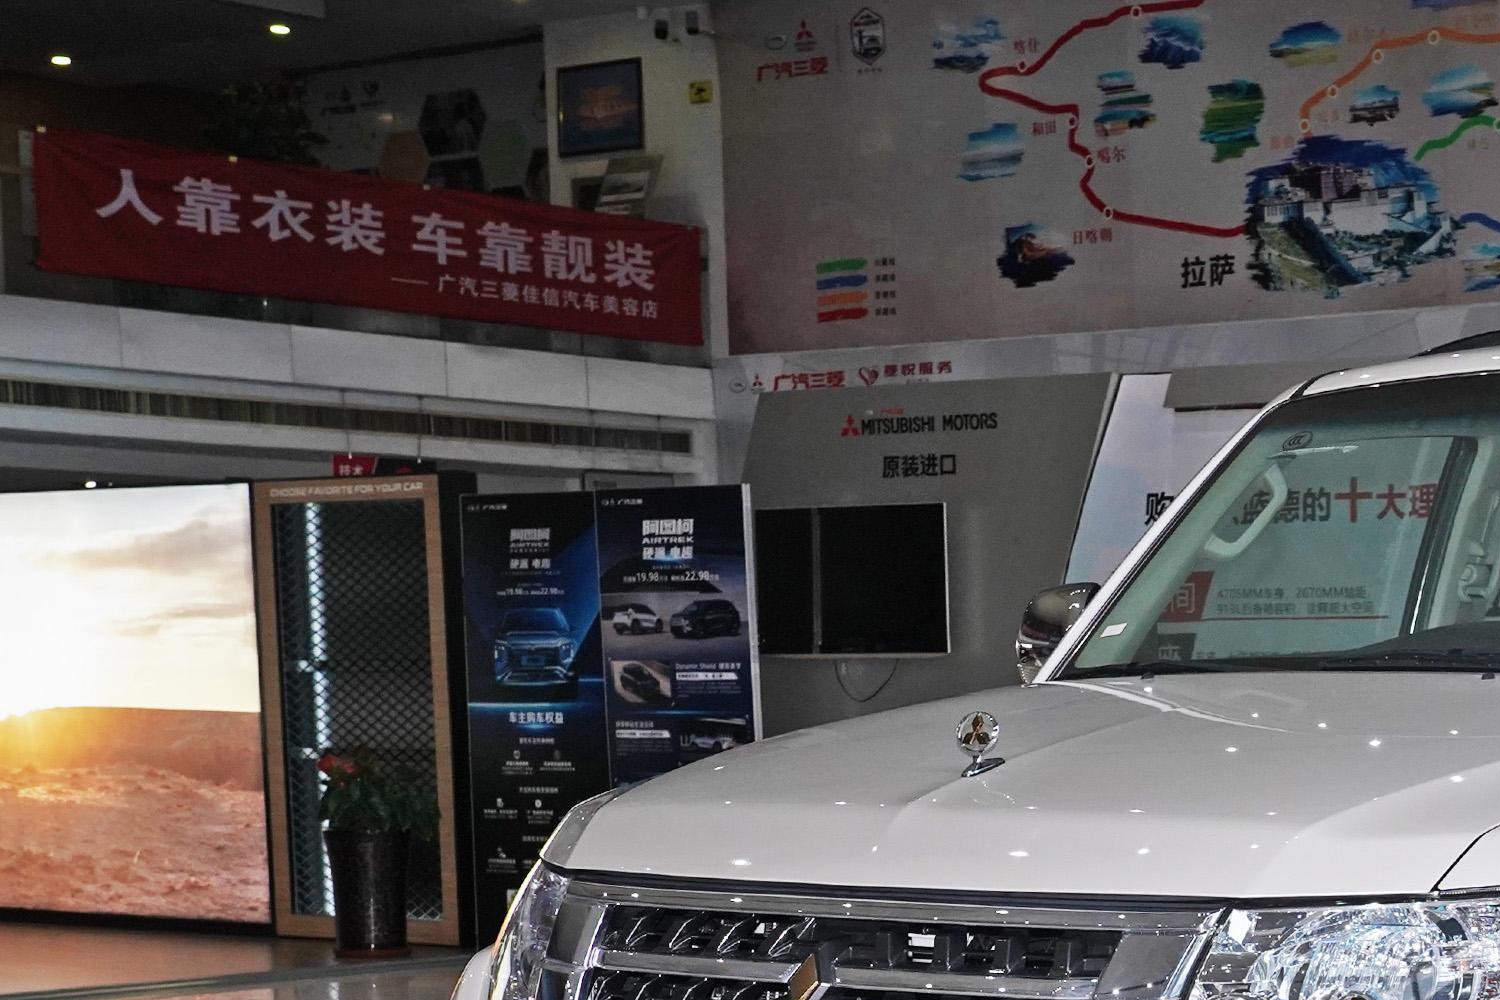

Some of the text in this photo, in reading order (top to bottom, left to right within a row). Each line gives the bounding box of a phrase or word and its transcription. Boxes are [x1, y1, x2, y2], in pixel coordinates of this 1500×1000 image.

[757, 57, 828, 81] 广汽三菱
[96, 168, 656, 291] 人靠衣装 车靠靓装
[1180, 254, 1236, 289] 拉萨
[774, 370, 845, 391] 广汽三菱
[861, 412, 998, 436] MITSUBISHI MOTORS
[882, 454, 956, 478] 原装进口
[355, 484, 374, 494] FOR
[403, 482, 424, 492] CAR
[642, 536, 694, 544] AIRTREK
